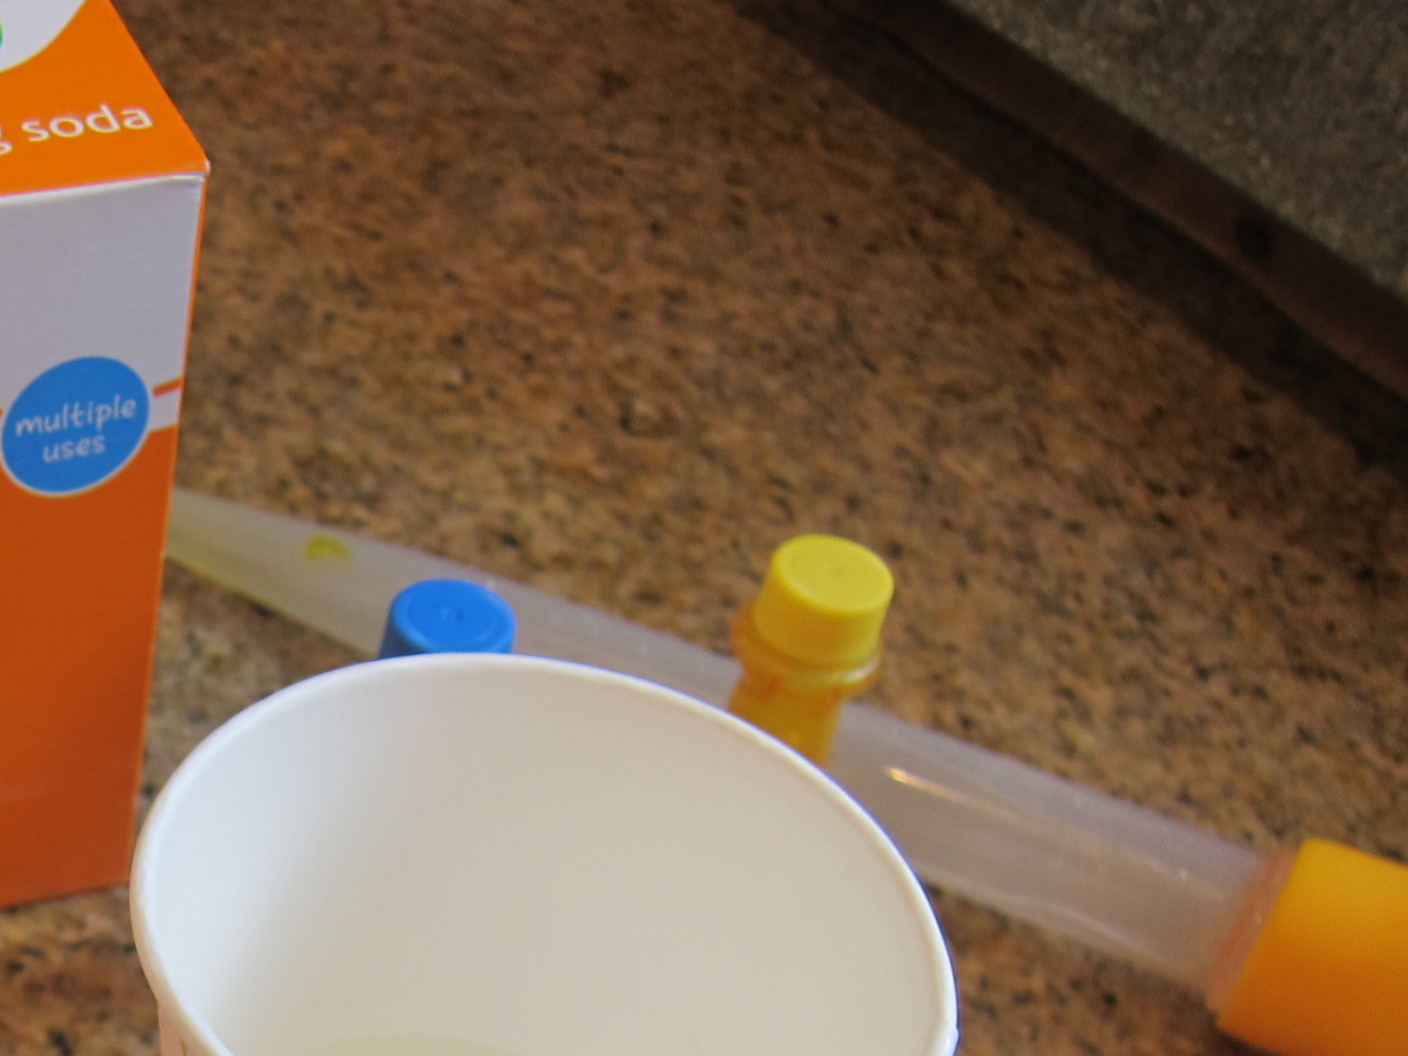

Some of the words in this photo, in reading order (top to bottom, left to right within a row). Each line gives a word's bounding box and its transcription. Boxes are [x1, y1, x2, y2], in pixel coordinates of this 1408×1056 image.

[20, 103, 154, 144] soda
[15, 394, 138, 437] multiple
[42, 434, 107, 463] uses
